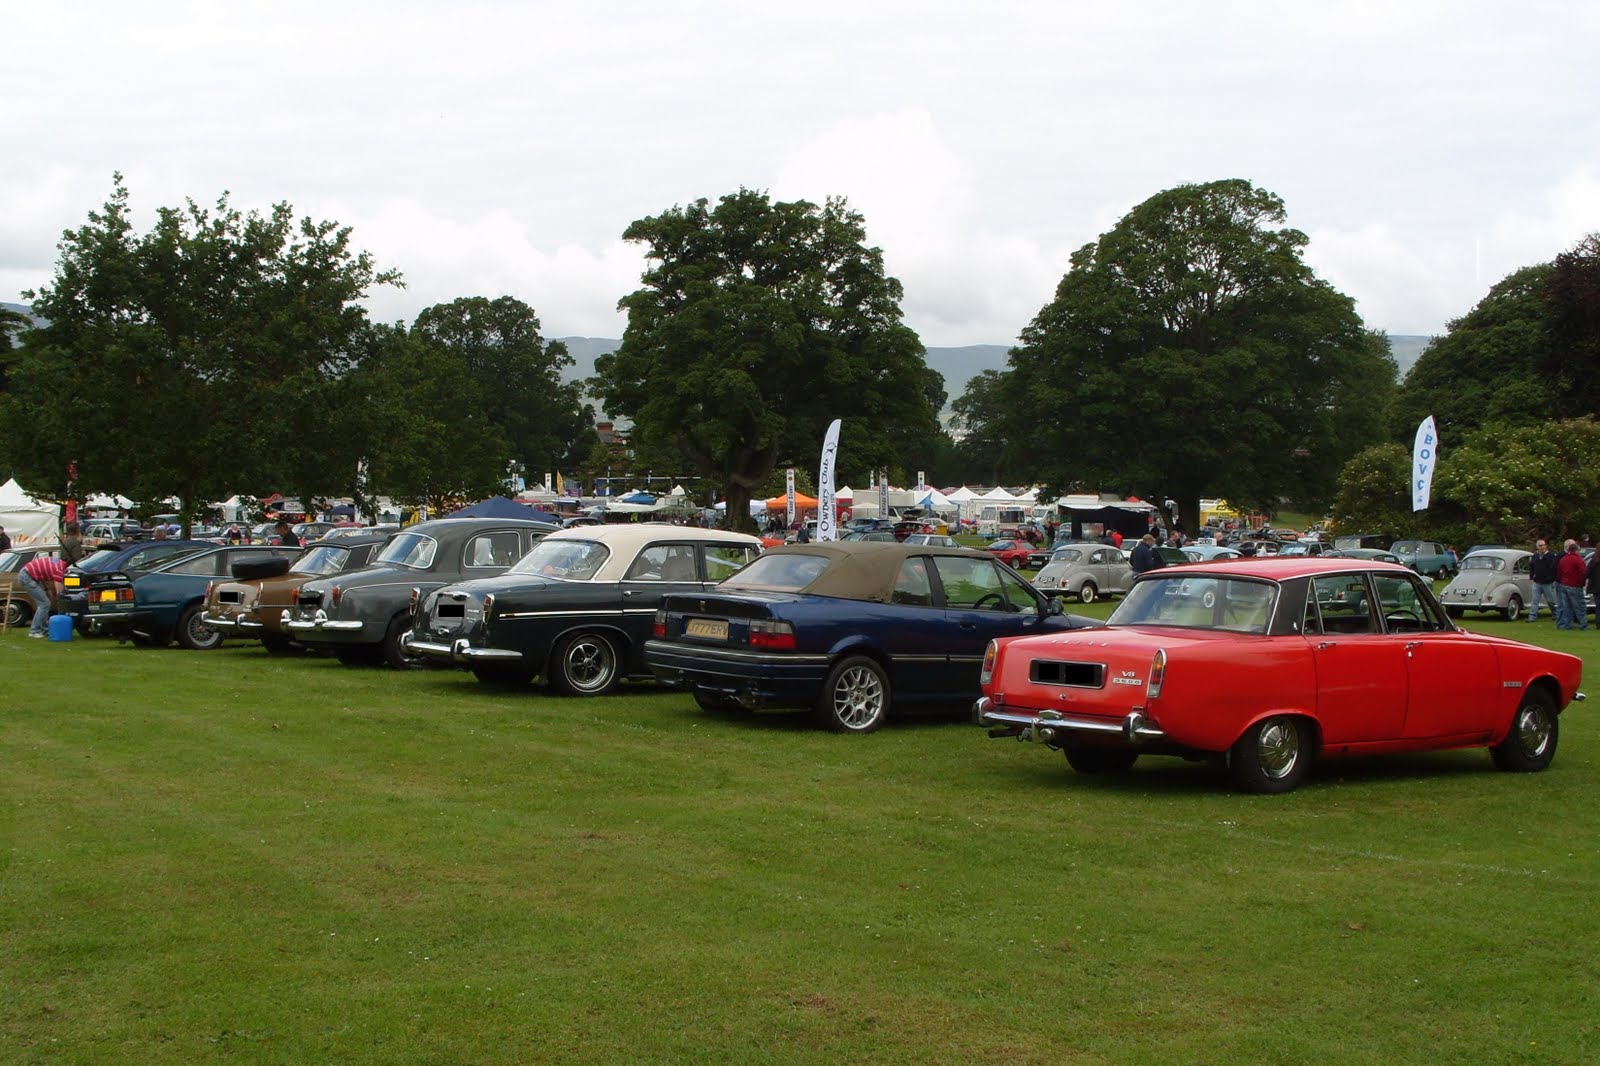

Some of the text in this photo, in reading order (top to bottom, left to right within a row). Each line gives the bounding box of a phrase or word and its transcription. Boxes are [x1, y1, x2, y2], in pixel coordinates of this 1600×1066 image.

[821, 458, 829, 485] Club
[1417, 434, 1433, 491] BOVC
[821, 488, 830, 532] Owners
